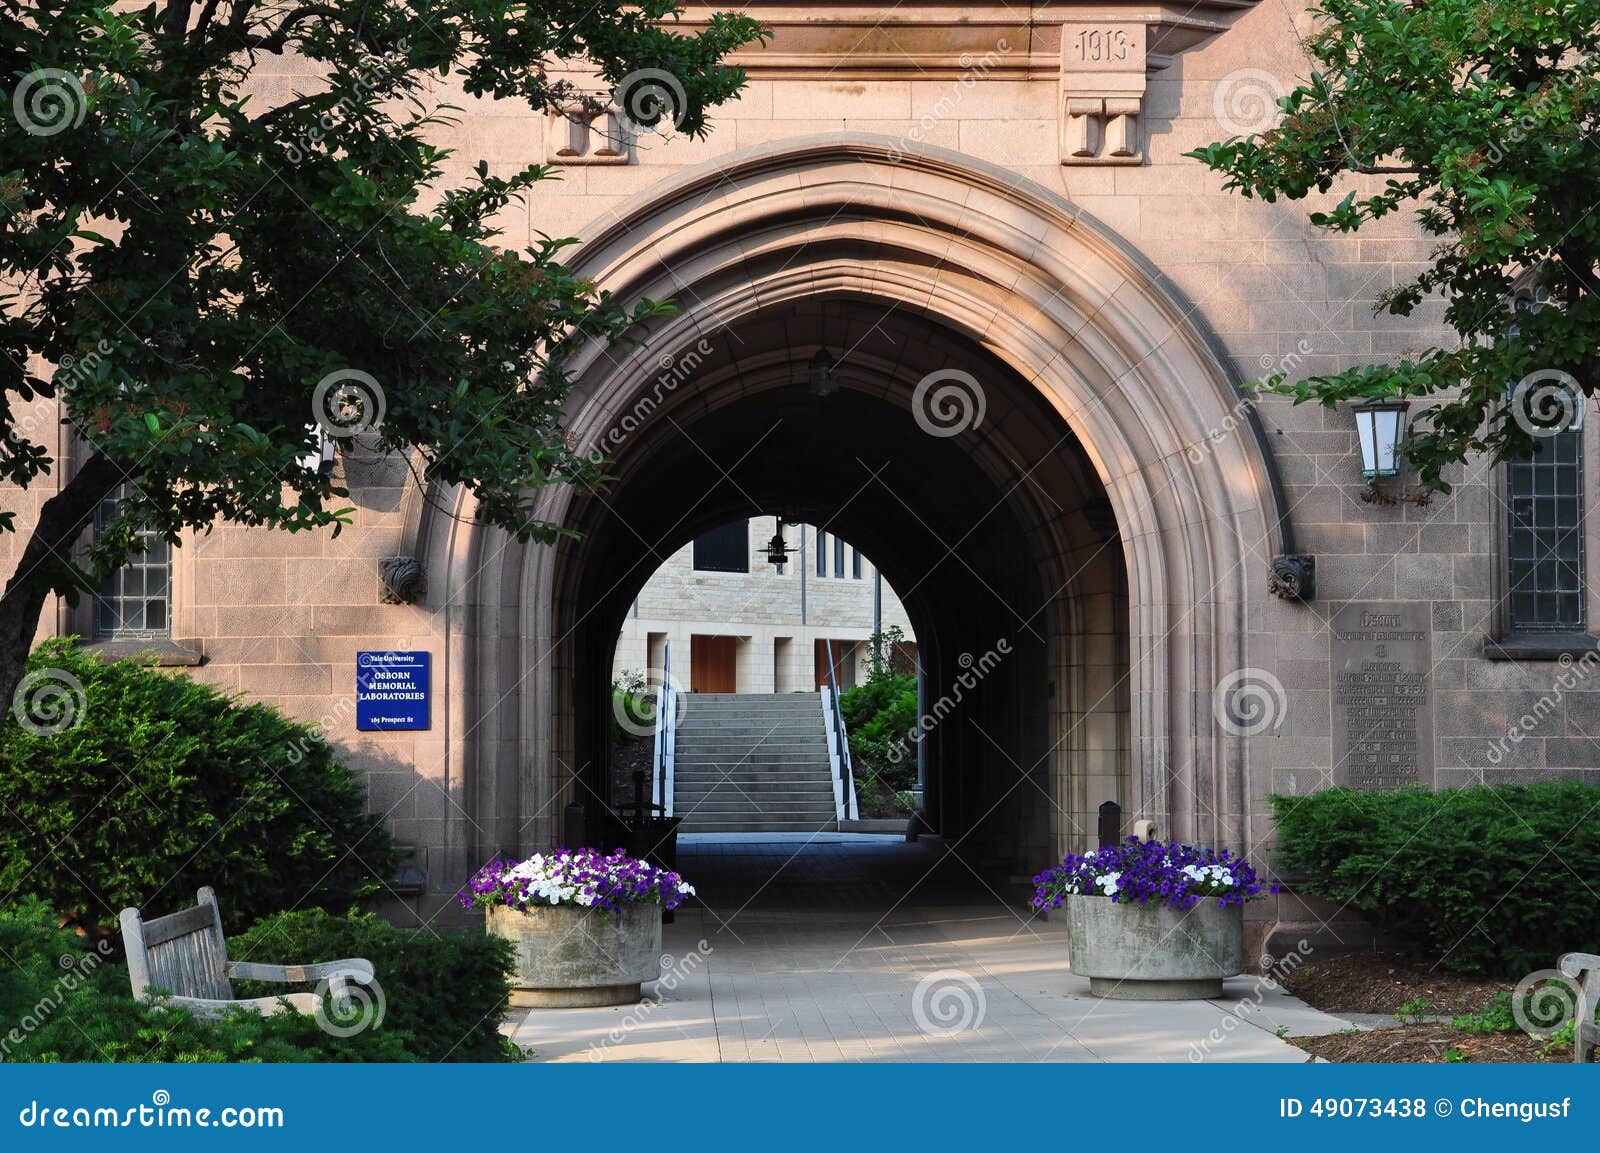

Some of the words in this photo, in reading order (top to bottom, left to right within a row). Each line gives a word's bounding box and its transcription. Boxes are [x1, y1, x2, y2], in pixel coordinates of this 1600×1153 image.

[383, 655, 415, 663] University
[374, 672, 411, 680] OSBORN
[368, 682, 417, 690] MEMORIAL
[360, 692, 425, 701] LABORATORIES
[381, 716, 406, 724] Prospect
